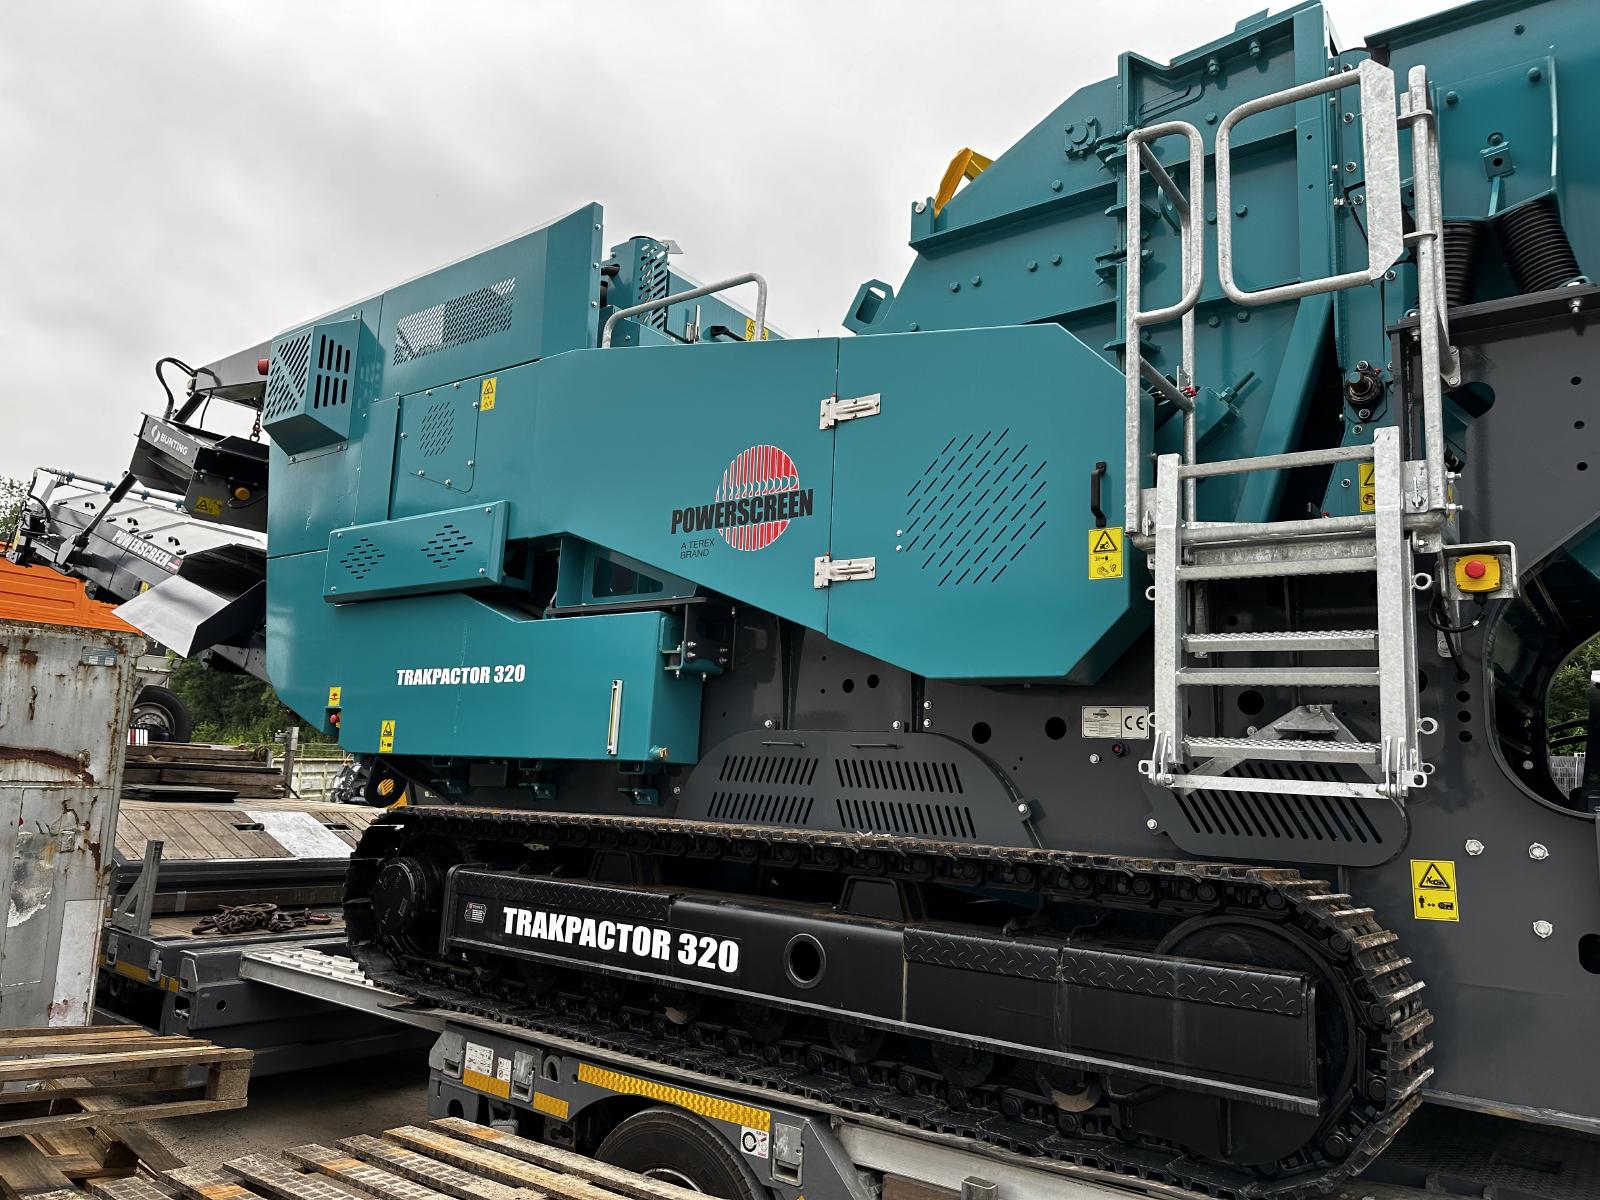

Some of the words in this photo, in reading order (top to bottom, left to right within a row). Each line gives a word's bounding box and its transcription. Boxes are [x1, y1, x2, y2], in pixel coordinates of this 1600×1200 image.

[160, 432, 188, 456] BUNTING
[671, 489, 814, 535] POWERSCREEN
[112, 530, 172, 567] POWERSCREEN
[680, 549, 709, 560] BRAND
[681, 540, 687, 549] A
[689, 538, 715, 549] TEREX
[396, 667, 490, 686] TRAKPACTOR
[494, 664, 526, 683] 320
[1124, 715, 1145, 731] CE
[503, 906, 671, 961] TRAKPACTOR
[677, 933, 739, 973] 320
